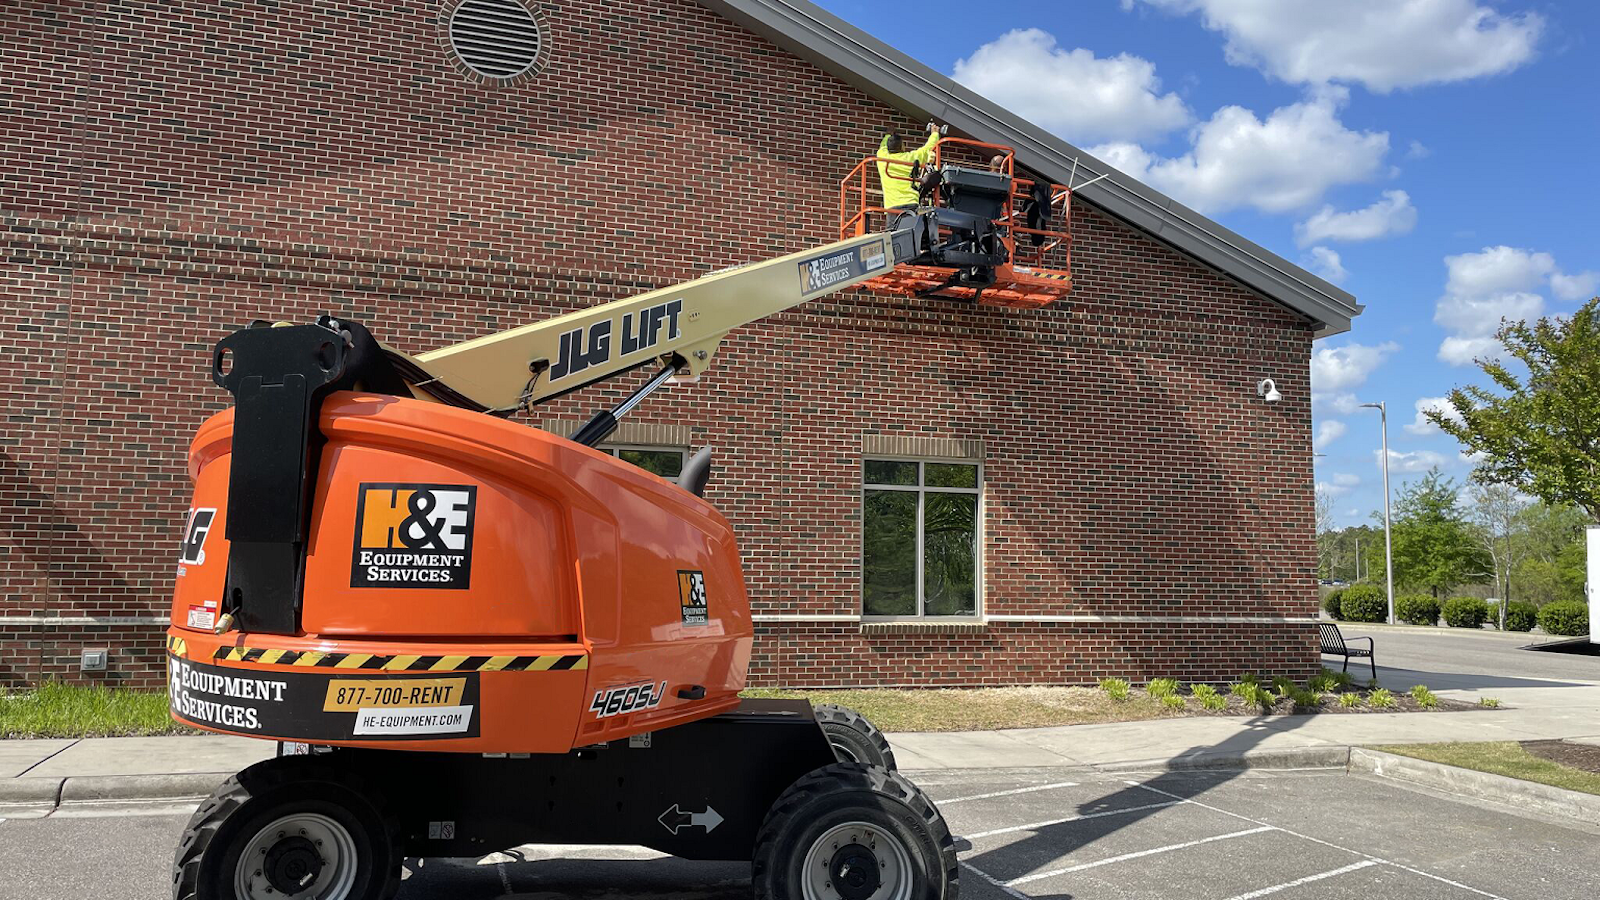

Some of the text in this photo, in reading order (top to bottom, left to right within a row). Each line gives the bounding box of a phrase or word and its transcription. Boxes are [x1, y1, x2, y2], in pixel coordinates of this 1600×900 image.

[549, 299, 682, 383] JLG LIFT
[361, 489, 469, 550] H&E
[359, 551, 464, 567] EQUIPMENT
[679, 574, 706, 605] H&E
[181, 663, 287, 701] EQUIPMENT
[337, 686, 453, 704] 877-700-RENT
[589, 681, 667, 719] 460SJ
[363, 714, 462, 727] HE-EQUIPMENT.COM
